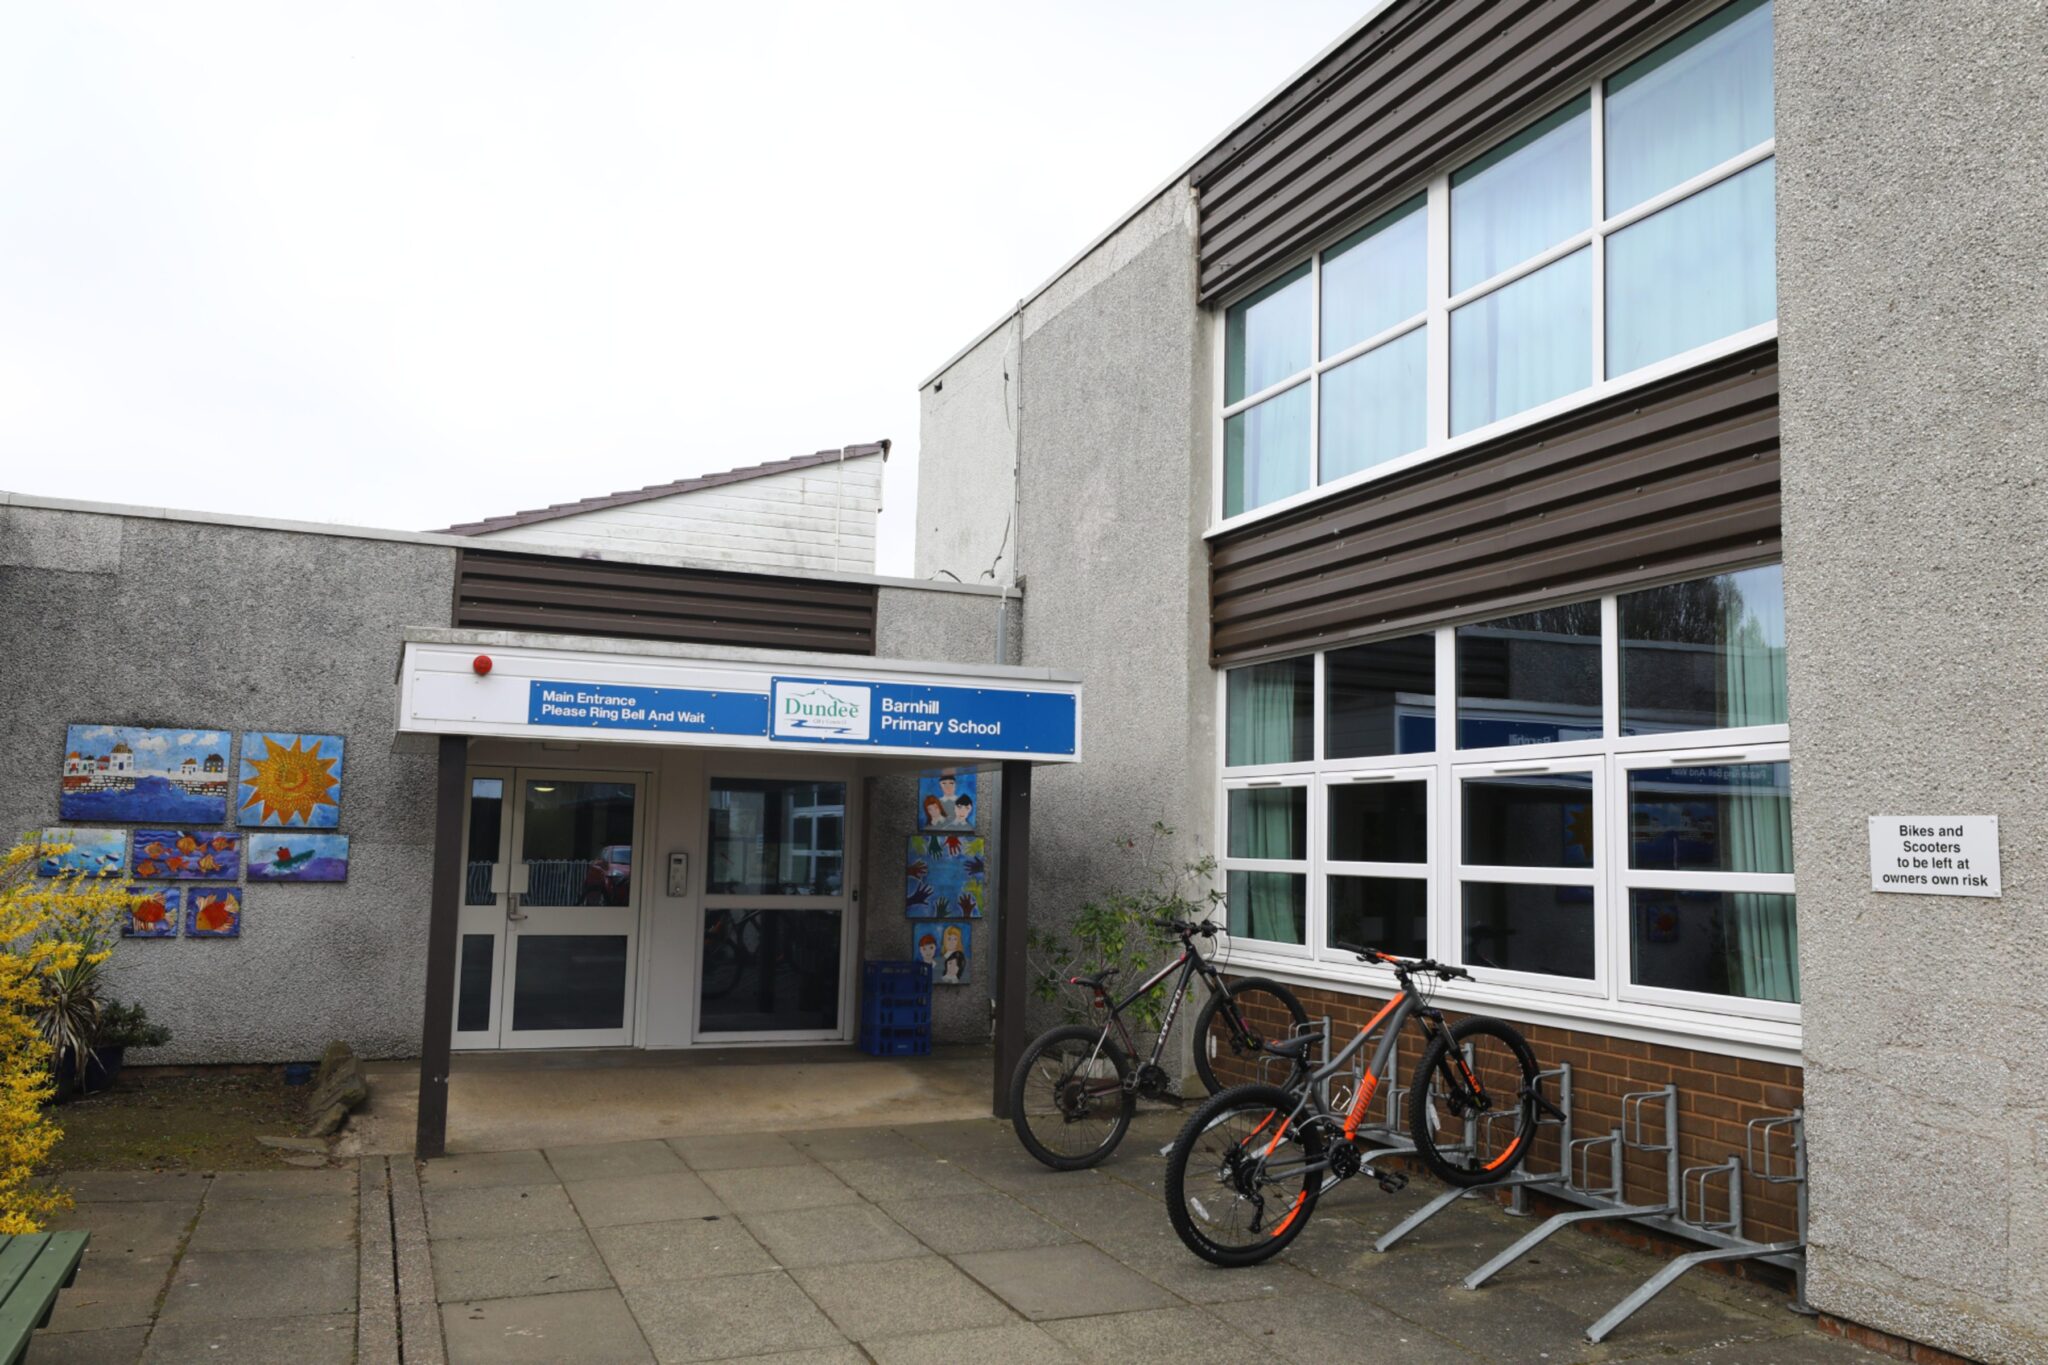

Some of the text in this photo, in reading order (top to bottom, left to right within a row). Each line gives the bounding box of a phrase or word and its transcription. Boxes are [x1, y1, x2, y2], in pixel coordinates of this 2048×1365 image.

[543, 690, 636, 706] Main Entrance
[882, 697, 940, 715] Barnhill
[542, 704, 706, 723] Please Ring Bell And Wait
[785, 697, 859, 718] Dundee
[881, 715, 1001, 735] Primary School
[1899, 825, 1963, 837] Bikes and
[1903, 840, 1961, 853] Scooters
[1897, 857, 1970, 870] to be left at
[1882, 874, 1988, 887] owners own risk
